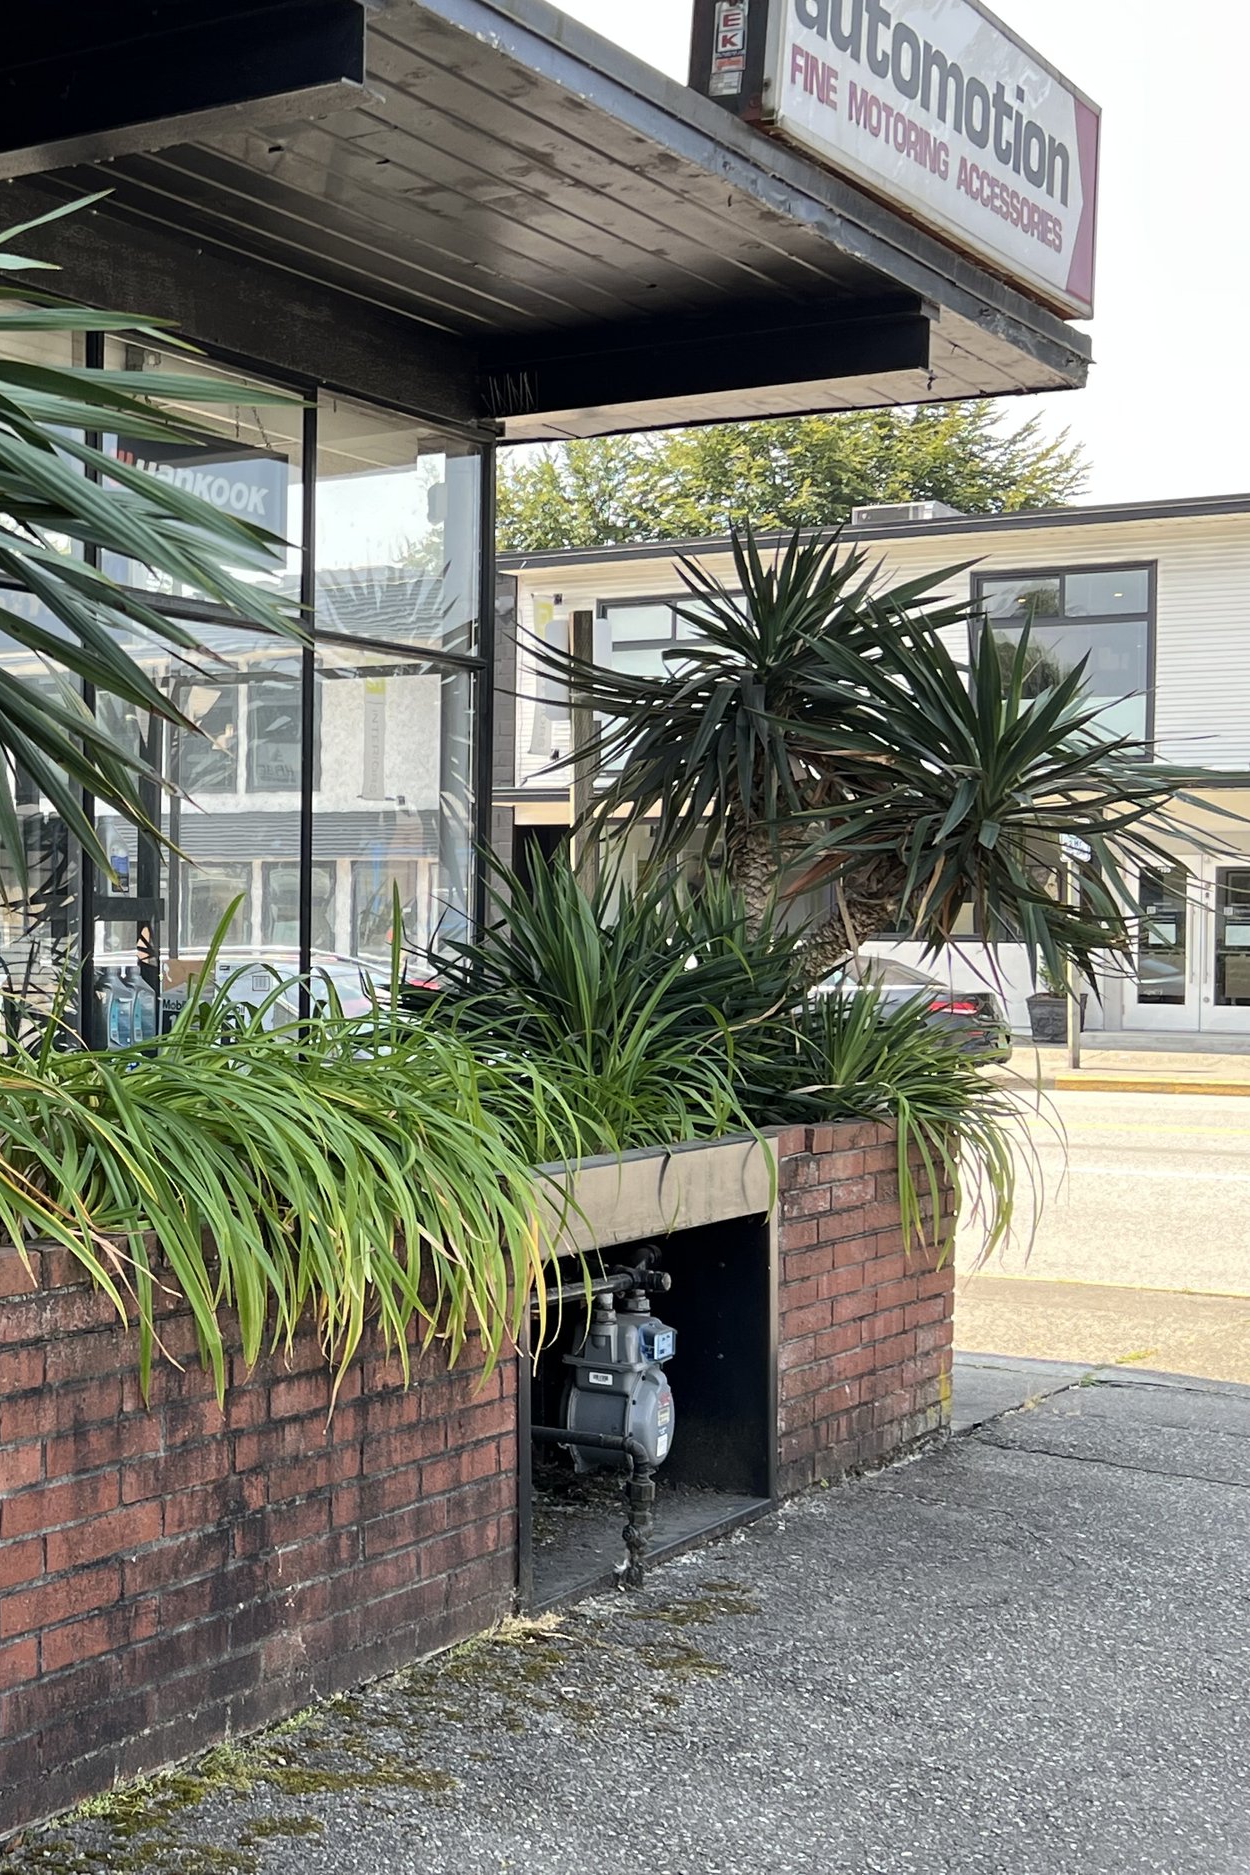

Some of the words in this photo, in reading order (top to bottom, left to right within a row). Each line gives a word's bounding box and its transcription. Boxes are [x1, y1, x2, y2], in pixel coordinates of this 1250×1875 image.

[791, 43, 838, 111] FINE
[848, 80, 950, 181] MOTORING
[956, 156, 1063, 254] ACCESSORIES
